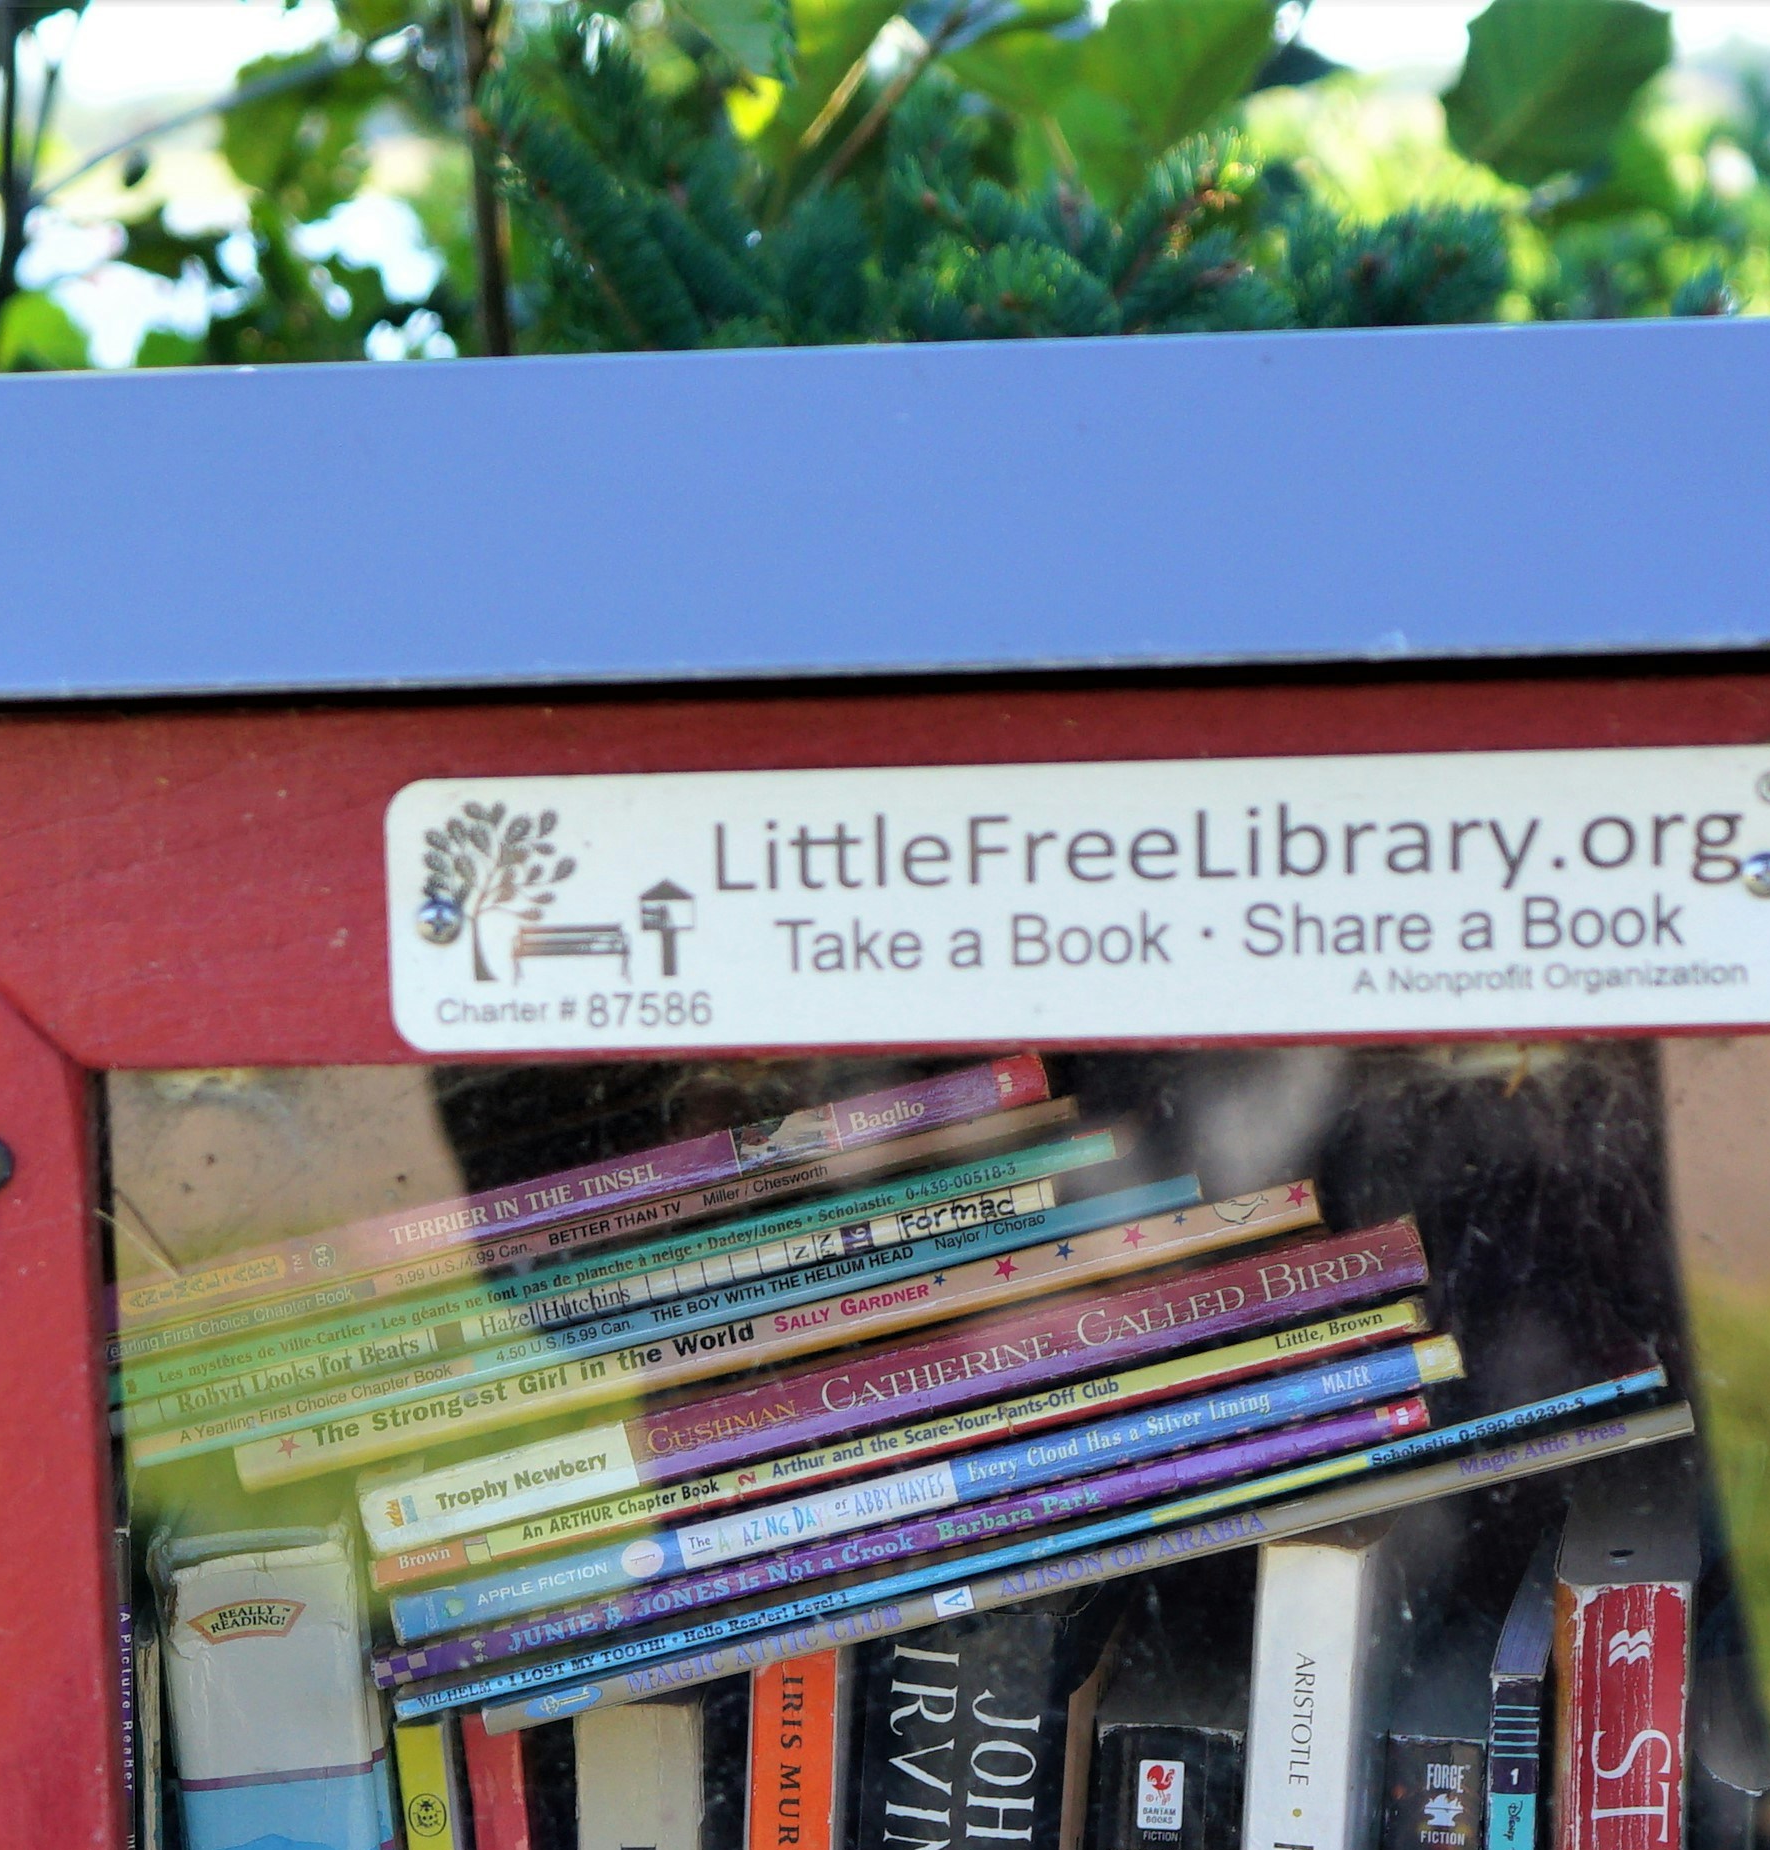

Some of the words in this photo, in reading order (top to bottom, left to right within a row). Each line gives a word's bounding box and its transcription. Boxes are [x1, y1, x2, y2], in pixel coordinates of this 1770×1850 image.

[715, 803, 1743, 890] LittleFreeLibrary.org
[776, 918, 922, 973] Take
[948, 929, 983, 969] a
[1012, 911, 1170, 967] Book
[1243, 900, 1433, 957] Share
[1460, 910, 1494, 951] a
[1523, 895, 1683, 951] Book
[437, 999, 547, 1025] Charter
[588, 992, 712, 1026] 87586
[1354, 972, 1376, 992] A
[1388, 965, 1532, 994] Nonprofit
[1548, 961, 1747, 990] Organization
[389, 1206, 490, 1245] TERRIER
[495, 1198, 519, 1219] IN
[525, 1184, 573, 1211] THE
[579, 1163, 662, 1196] TINSEL
[849, 1099, 925, 1132] Baglio
[548, 1221, 610, 1246] BETTER
[614, 1208, 658, 1233] THAN
[703, 1187, 740, 1207] Miller
[753, 1164, 828, 1194] Chesworth
[900, 1195, 1015, 1240] Formac
[650, 1305, 685, 1323] THE
[687, 1296, 719, 1316] BOY
[724, 1285, 766, 1308] WITH
[770, 1275, 801, 1295] THE
[803, 1258, 865, 1286] HELIUM
[870, 1246, 913, 1268] HEAD
[935, 1230, 982, 1250] Naylor
[313, 1420, 360, 1447] The
[372, 1381, 507, 1431] Strongest
[519, 1366, 568, 1395] Girl
[580, 1358, 606, 1380] in
[617, 1345, 662, 1372] the
[672, 1321, 754, 1357] World
[774, 1307, 830, 1333] SALLY
[840, 1283, 930, 1318] GARDNER
[647, 1400, 798, 1454] CUSHMAN
[821, 1333, 1070, 1412] CATHERINE,
[1076, 1284, 1246, 1347] CALLED
[1257, 1244, 1390, 1302] BIRDY
[398, 1547, 451, 1570] Brown
[550, 1504, 613, 1533] ARTHUR
[617, 1492, 677, 1519] Chapter
[680, 1479, 720, 1500] Book
[772, 1454, 825, 1479] Arthur
[832, 1442, 865, 1463] and
[869, 1434, 899, 1455] the
[903, 1389, 1076, 1445] Scare-Your-Pants-Off
[1081, 1379, 1120, 1402] Club
[1275, 1330, 1324, 1351] Little,
[1327, 1312, 1383, 1336] Brown
[967, 1454, 1019, 1484] Every
[1026, 1435, 1082, 1467] Cloud
[1086, 1429, 1123, 1454] Has
[1145, 1410, 1203, 1437] Silver
[1209, 1391, 1272, 1420] Lining
[1322, 1365, 1373, 1395] MAZER
[436, 1480, 508, 1511] Trophy
[513, 1453, 608, 1490] Newbery
[477, 1582, 534, 1607] APPLE
[538, 1562, 608, 1592] FICTION
[508, 1611, 596, 1653] JUNIE
[637, 1582, 729, 1617] JONES
[840, 1534, 917, 1565] Crook
[936, 1503, 1034, 1540] Barbara
[1042, 1486, 1101, 1515] Park
[627, 1653, 723, 1694] MAGIC
[737, 1630, 818, 1668] ATTIC
[825, 1605, 902, 1641] CLUB
[998, 1554, 1103, 1599] ALISON
[1158, 1513, 1268, 1558] ARABIA
[211, 1614, 287, 1634] READING!
[219, 1605, 276, 1621] REALLY
[781, 1675, 804, 1750] IRIS
[1289, 1652, 1316, 1786] ARISTOTLE
[1427, 1763, 1466, 1792] FORGE
[1420, 1830, 1466, 1846] FICTION
